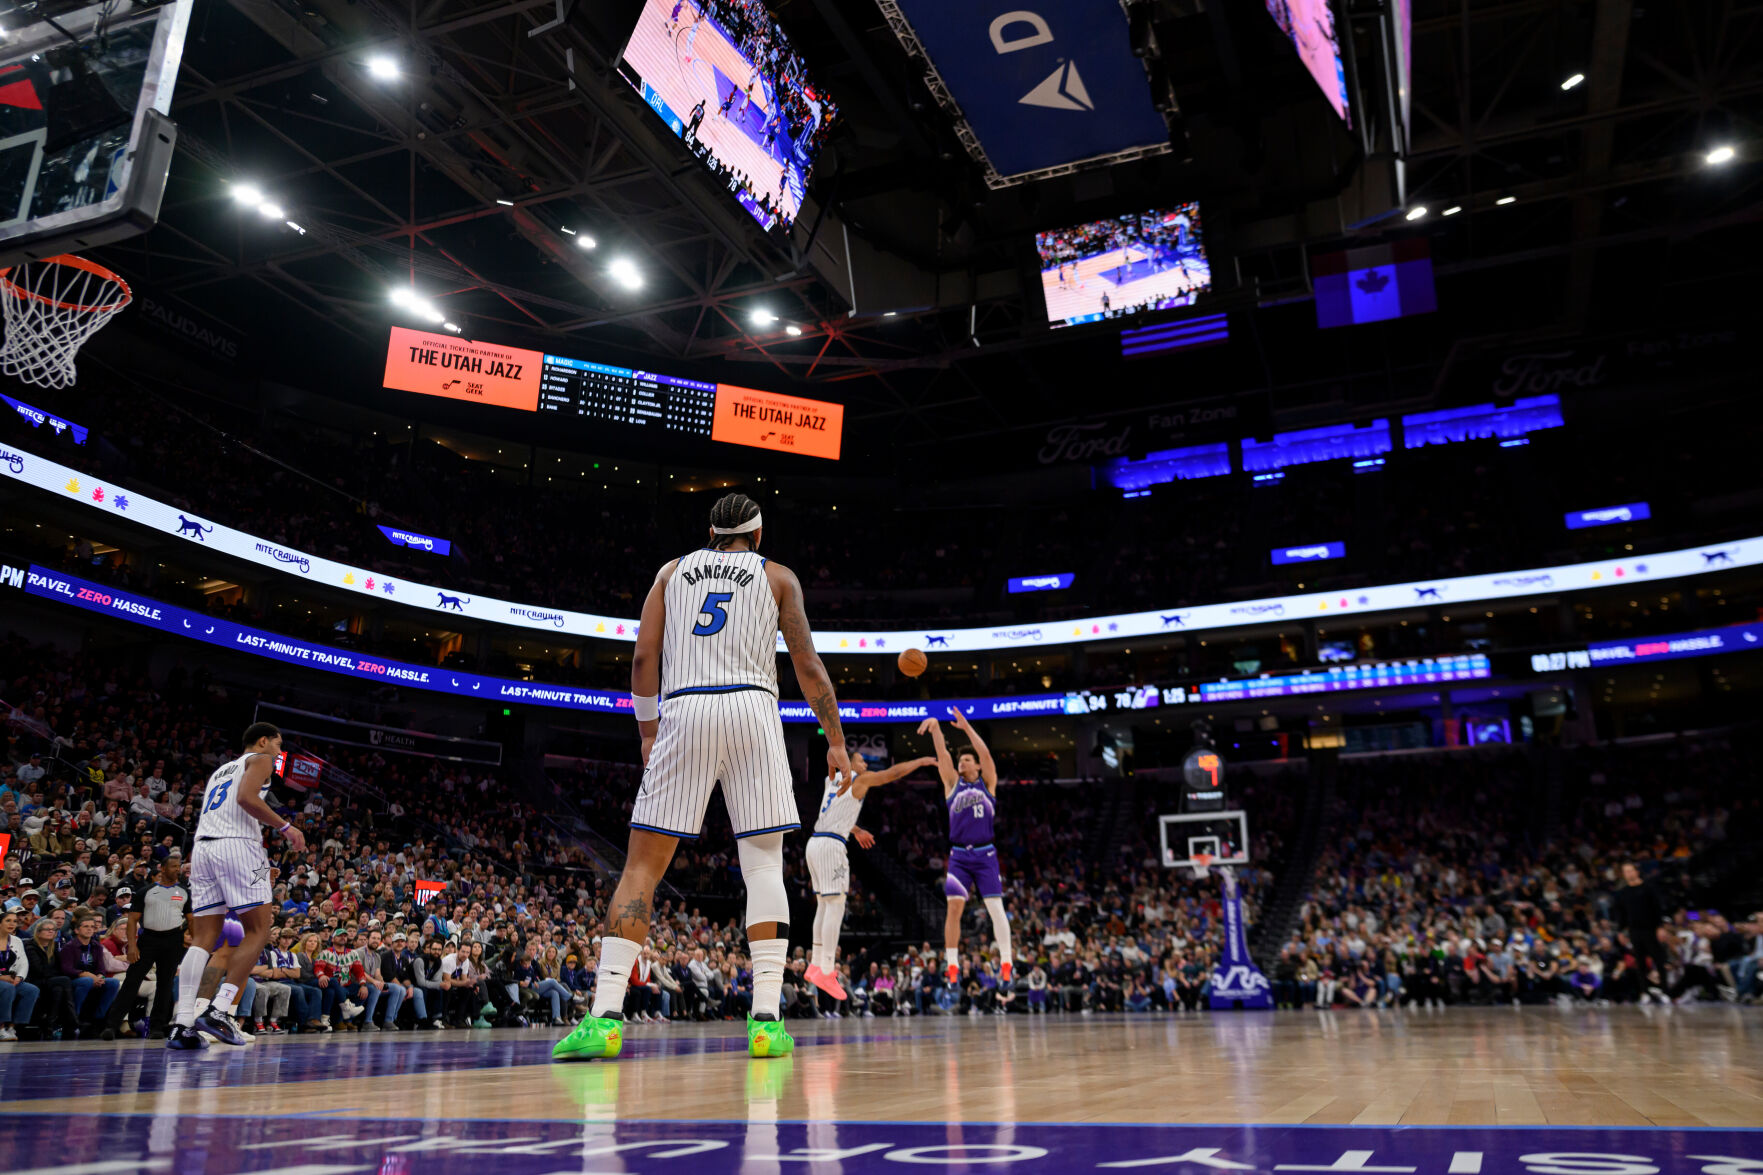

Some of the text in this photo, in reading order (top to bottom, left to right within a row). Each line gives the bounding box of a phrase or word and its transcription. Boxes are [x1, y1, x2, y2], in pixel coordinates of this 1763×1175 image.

[409, 346, 523, 381] THE UTAH JAZZ
[643, 373, 658, 382] JAZZ
[1492, 350, 1609, 398] Ford
[465, 388, 484, 397] GEEK
[467, 381, 484, 390] SEAT
[733, 402, 827, 431] THE UTAH JAZZ
[1147, 404, 1239, 431] Fan Zone
[1037, 420, 1133, 464] Ford
[255, 542, 310, 573] NITECRAWLER
[682, 564, 755, 587] BANCHERO
[28, 572, 162, 620] RAVEL, ZERO HASSLE.
[510, 607, 565, 628] NITECRAWLER
[692, 592, 734, 637] 5
[236, 633, 430, 683] LAST-MINUTE TRAVEL, ZERO HASSLE.
[501, 685, 635, 708] LAST-MINUTE TRAVEL, ZER
[860, 707, 888, 717] ZERO
[888, 706, 928, 717] HASSLE.
[203, 778, 233, 815] 13
[972, 804, 985, 819] 13
